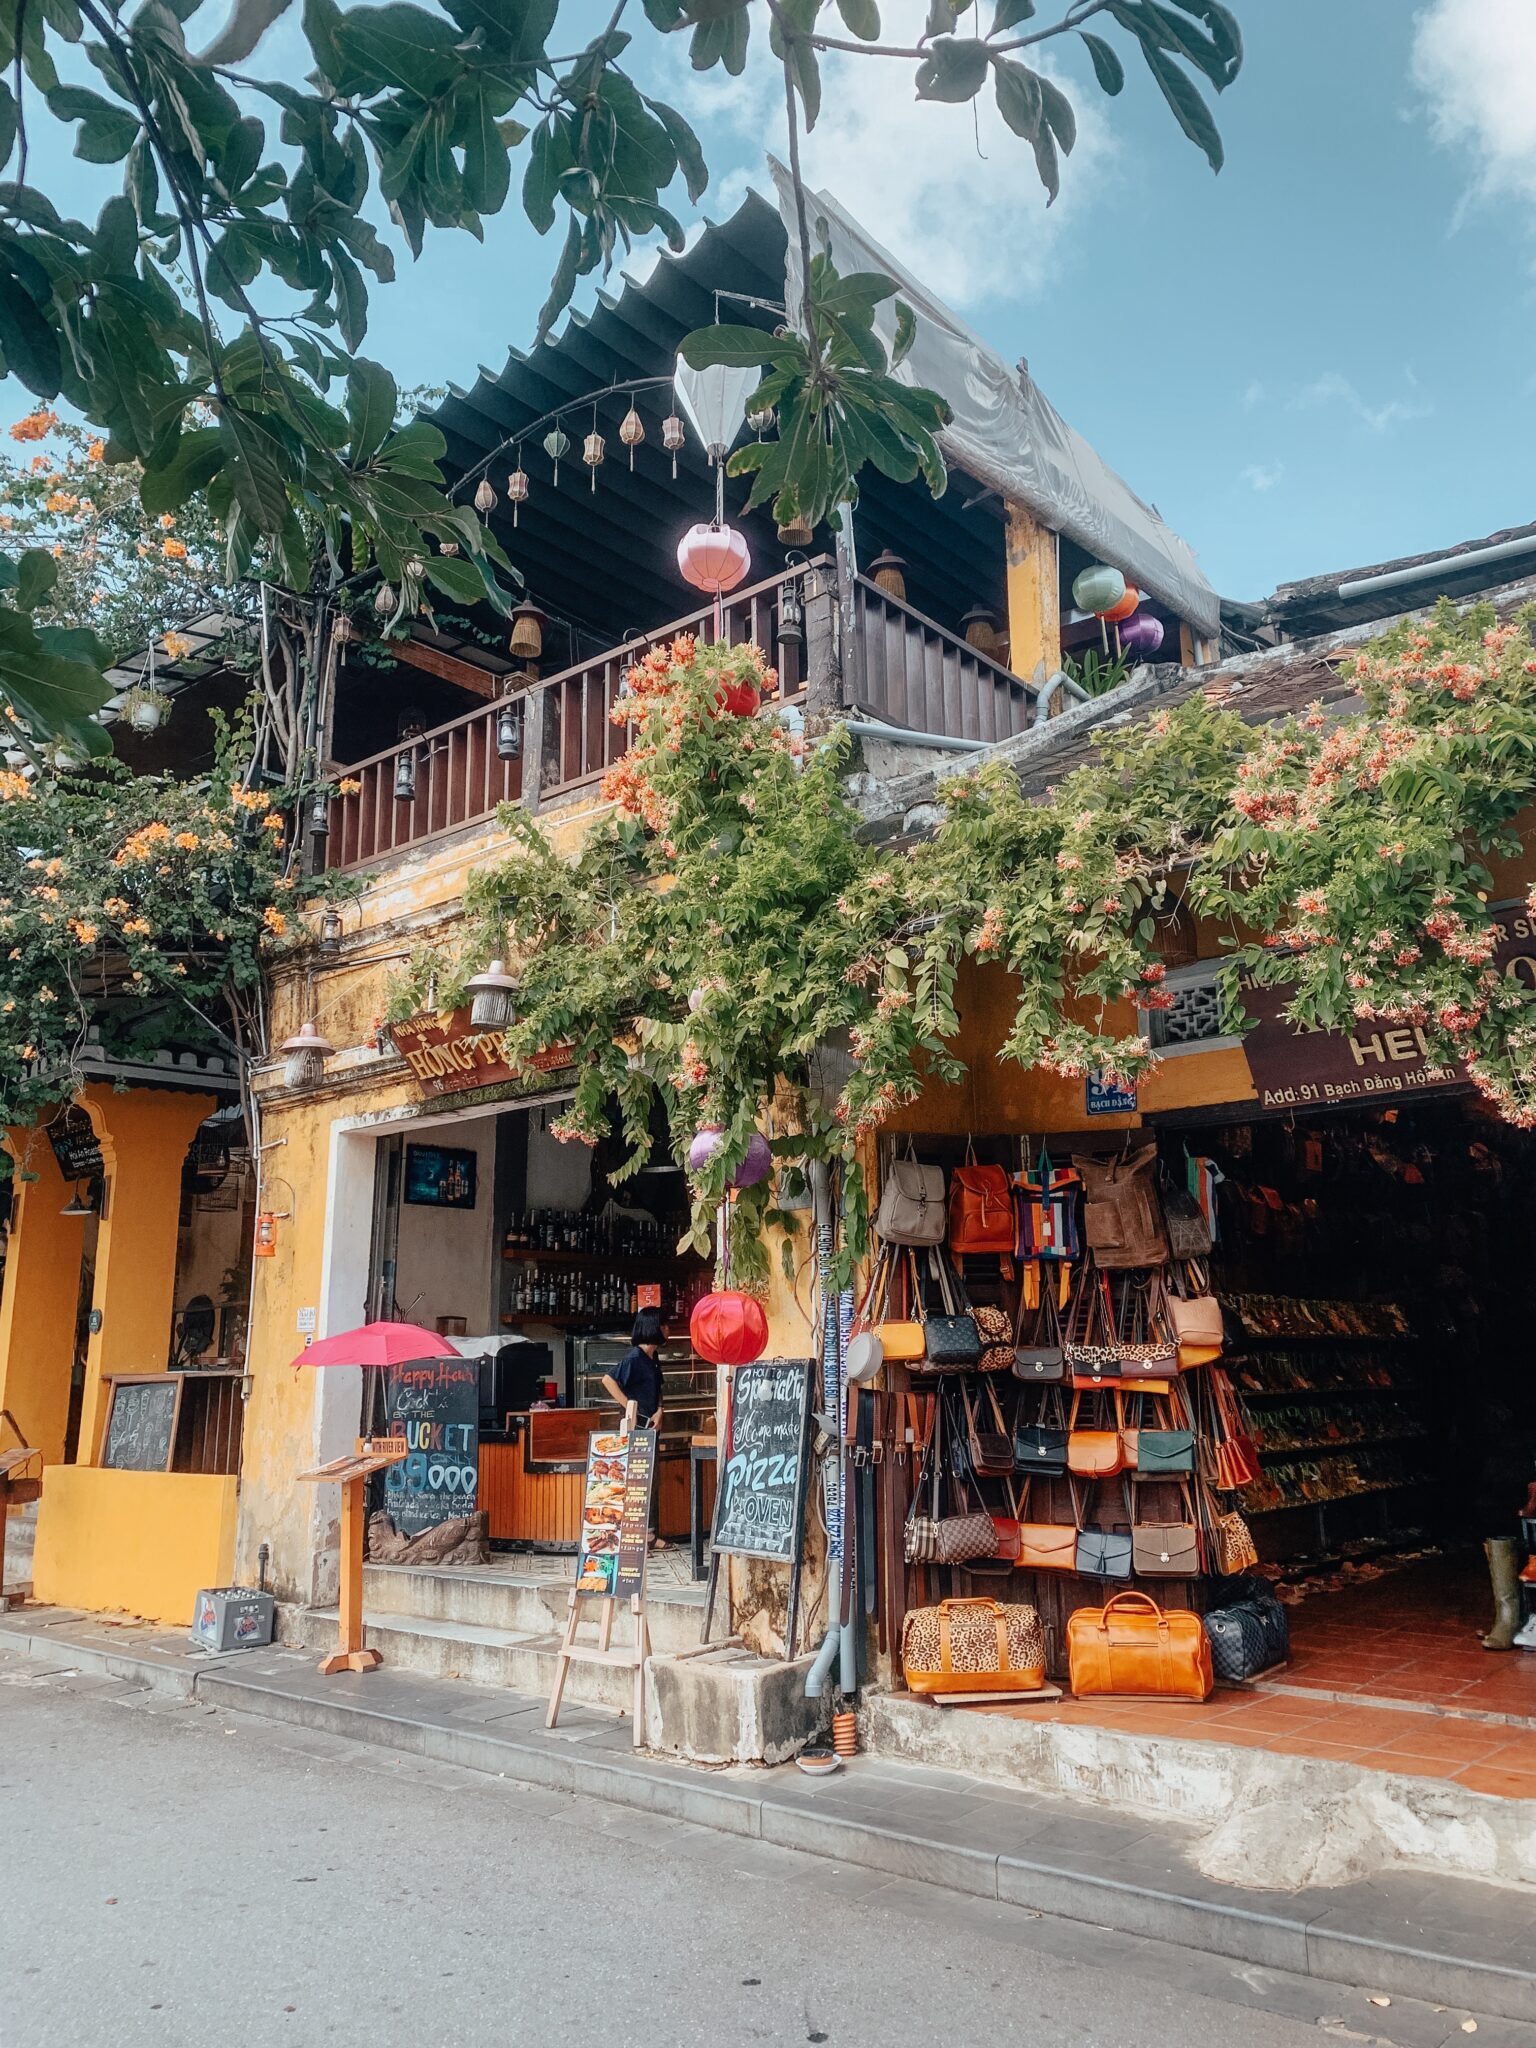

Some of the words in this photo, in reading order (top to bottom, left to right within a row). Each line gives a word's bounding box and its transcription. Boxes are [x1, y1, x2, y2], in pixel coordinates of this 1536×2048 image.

[1324, 1080, 1361, 1098] Bạch
[1363, 1072, 1403, 1091] Đằng
[411, 1410, 435, 1418] THE
[391, 1420, 475, 1452] BUCKET
[744, 1495, 792, 1528] OVEN
